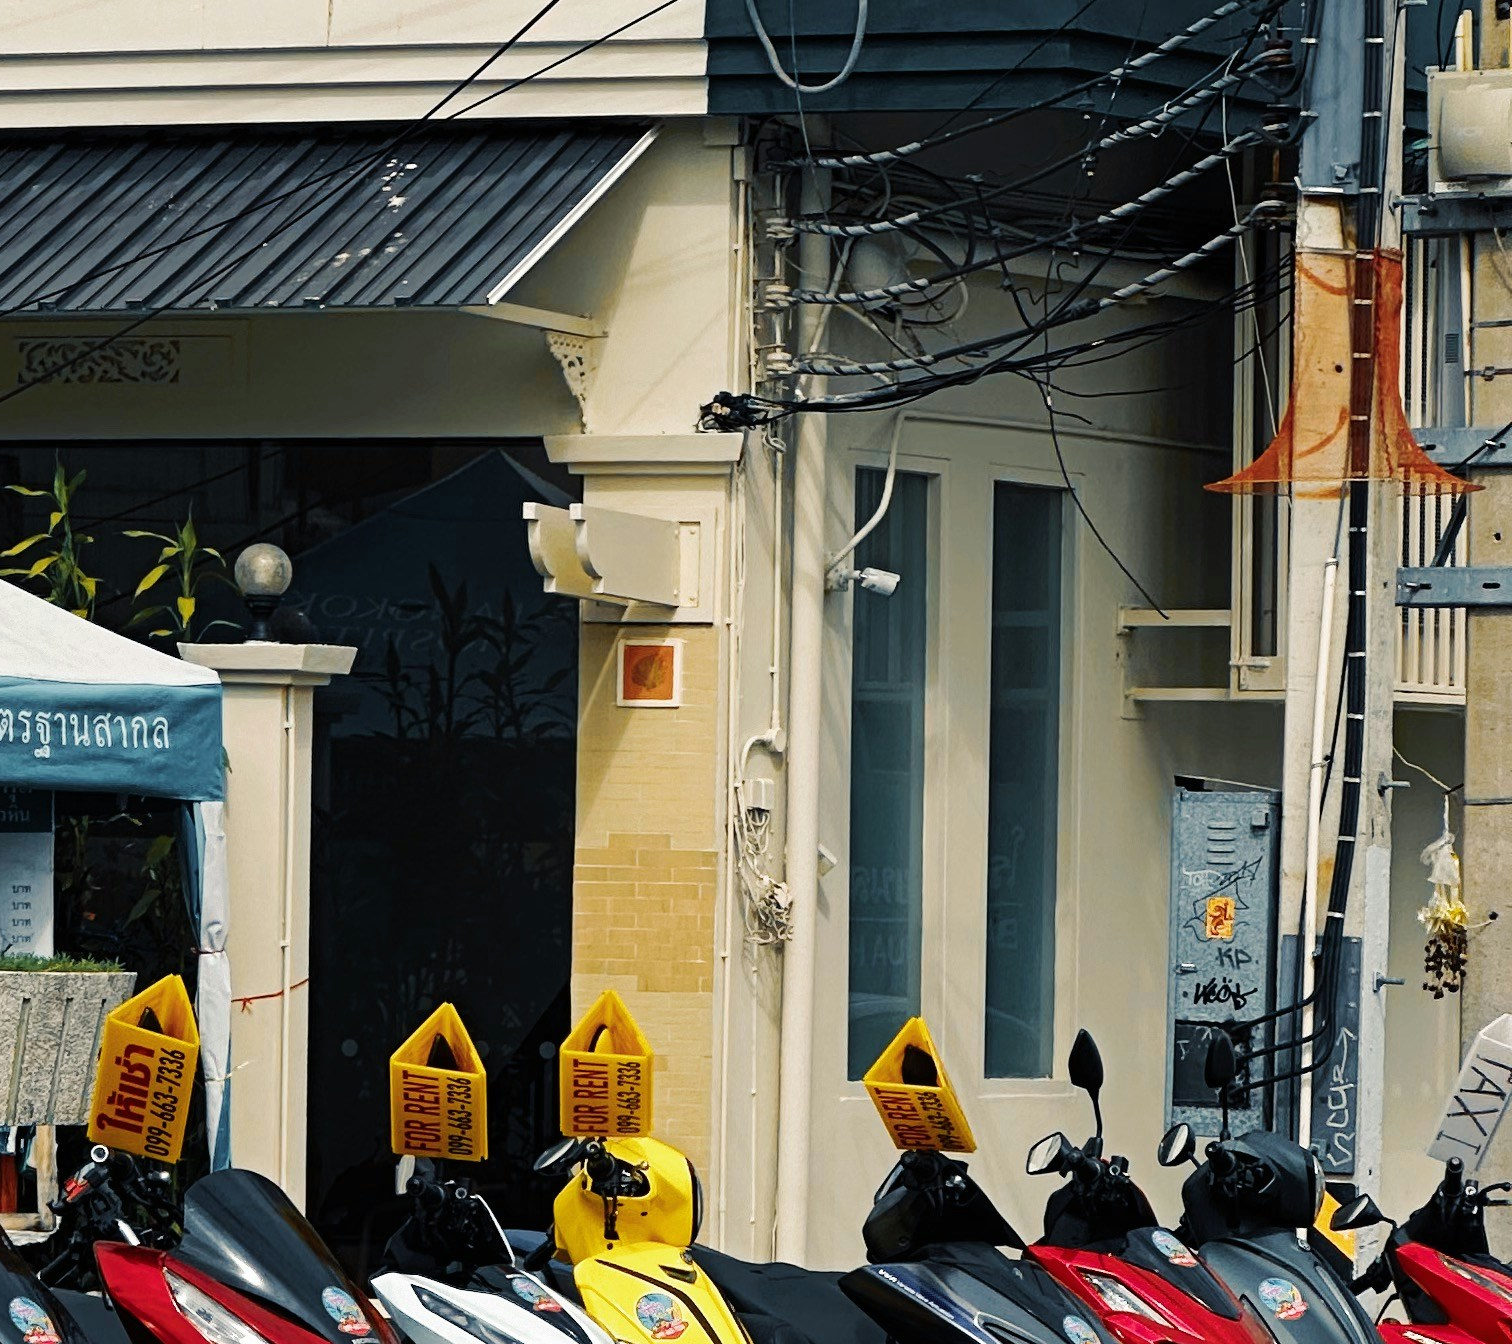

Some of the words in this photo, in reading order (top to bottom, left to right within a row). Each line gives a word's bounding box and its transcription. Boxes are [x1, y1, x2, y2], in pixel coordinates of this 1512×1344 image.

[96, 1043, 155, 1134] ให้เช่า
[402, 1069, 440, 1116] RENT
[572, 1058, 609, 1099] RENT
[616, 1061, 641, 1133] 099-663-7336
[143, 1047, 186, 1156] 099-663-7336
[446, 1076, 473, 1155] 099-663-7336
[572, 1104, 609, 1133] FOR
[873, 1087, 923, 1121] RENT
[404, 1119, 441, 1152] FOR
[893, 1123, 937, 1147] FOR
